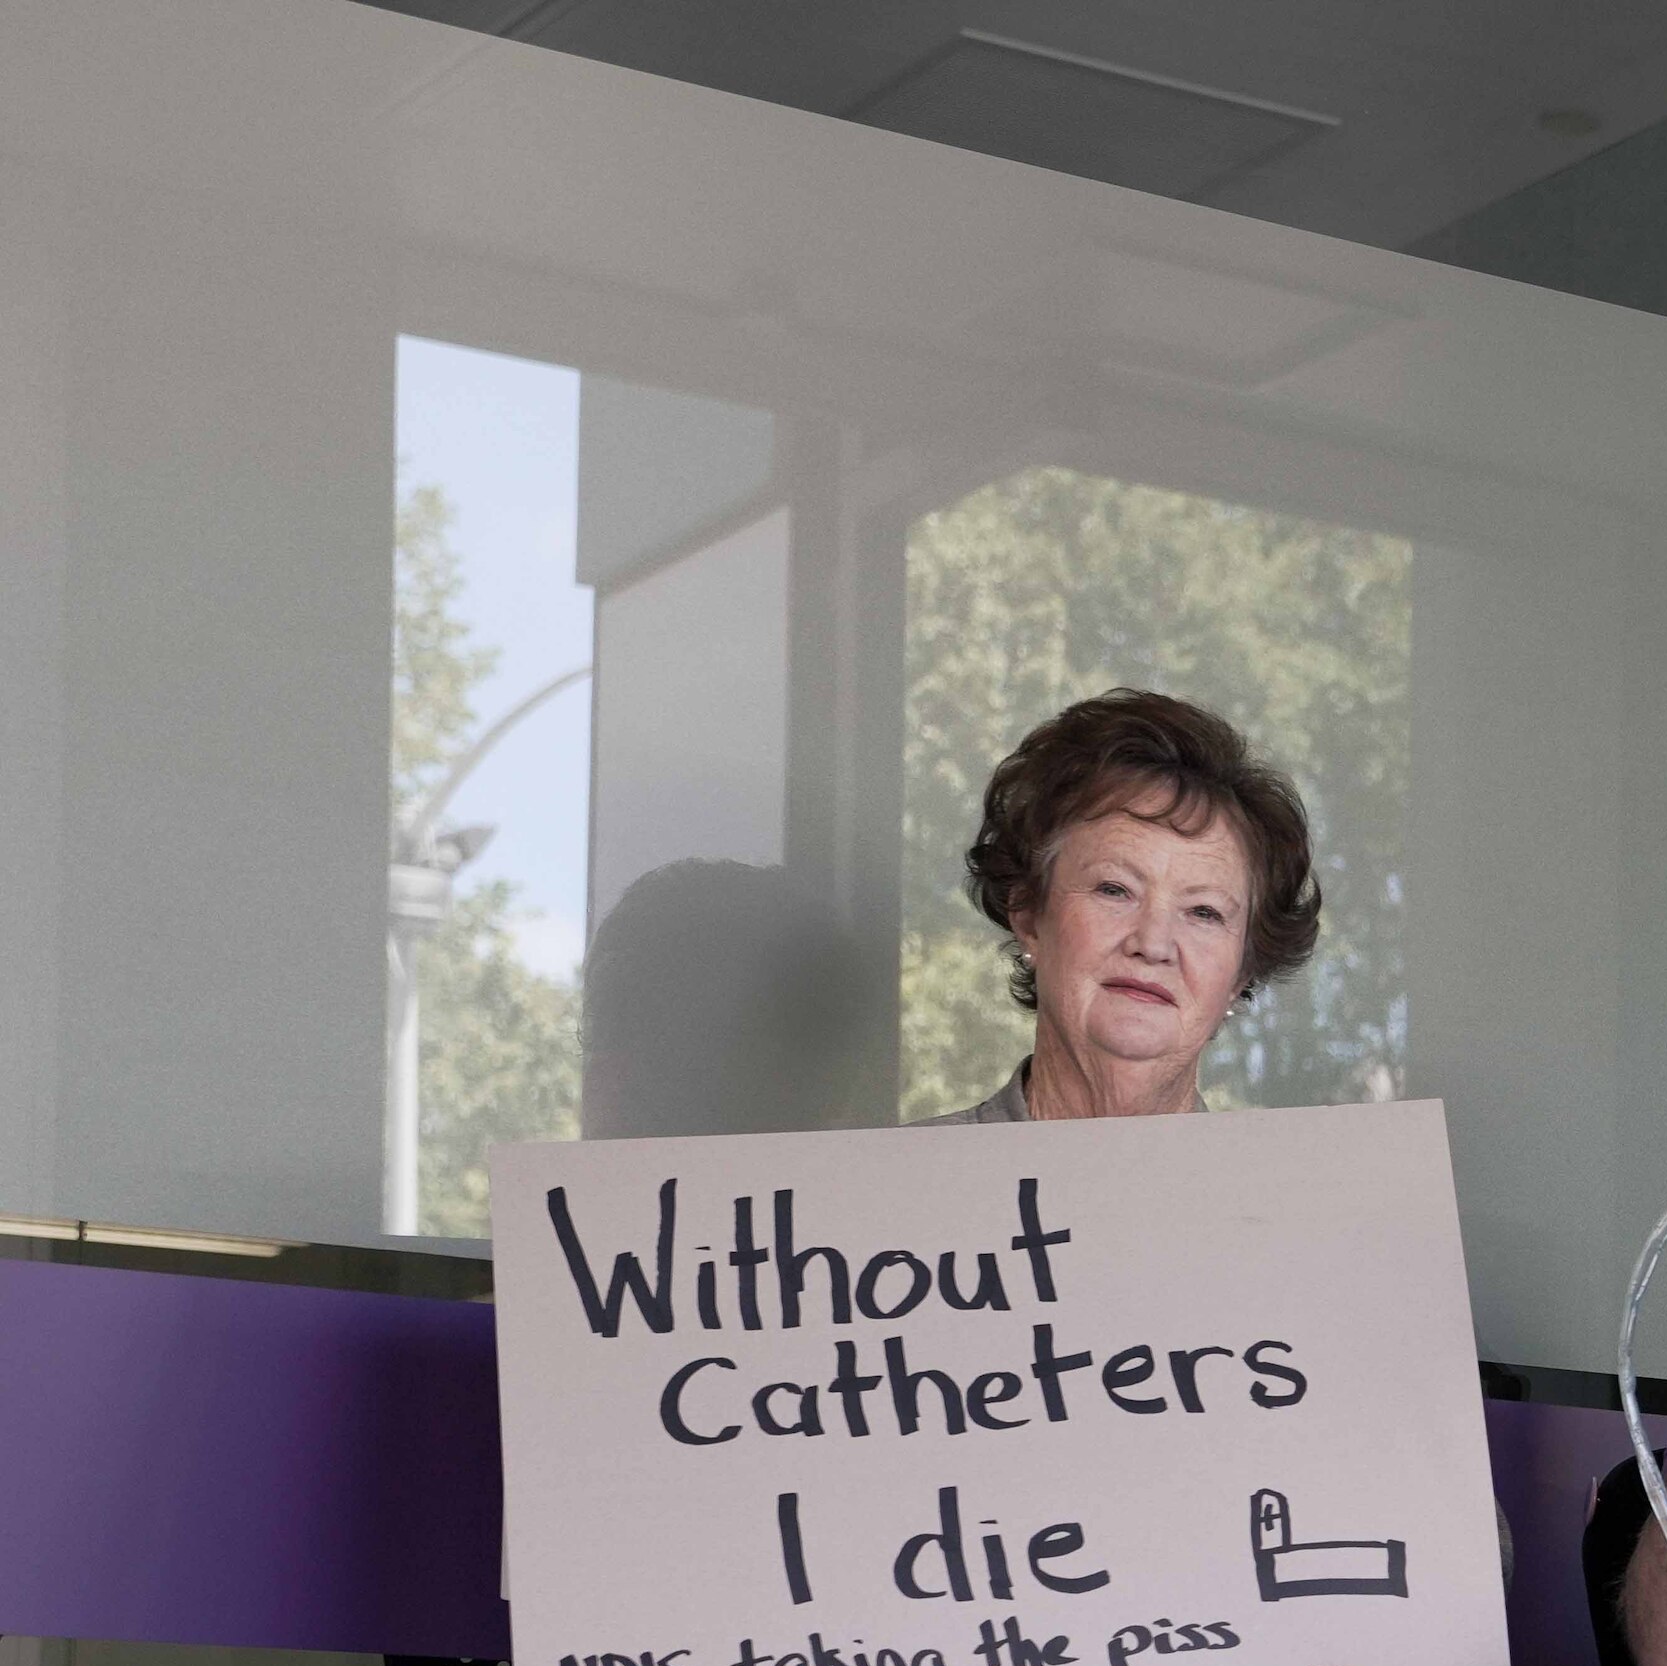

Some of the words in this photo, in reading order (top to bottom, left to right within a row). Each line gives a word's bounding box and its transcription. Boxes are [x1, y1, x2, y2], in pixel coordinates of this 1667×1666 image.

[546, 1178, 1070, 1337] Without
[660, 1324, 1307, 1445] Catheters
[776, 1492, 806, 1604] I
[892, 1486, 1110, 1602] die
